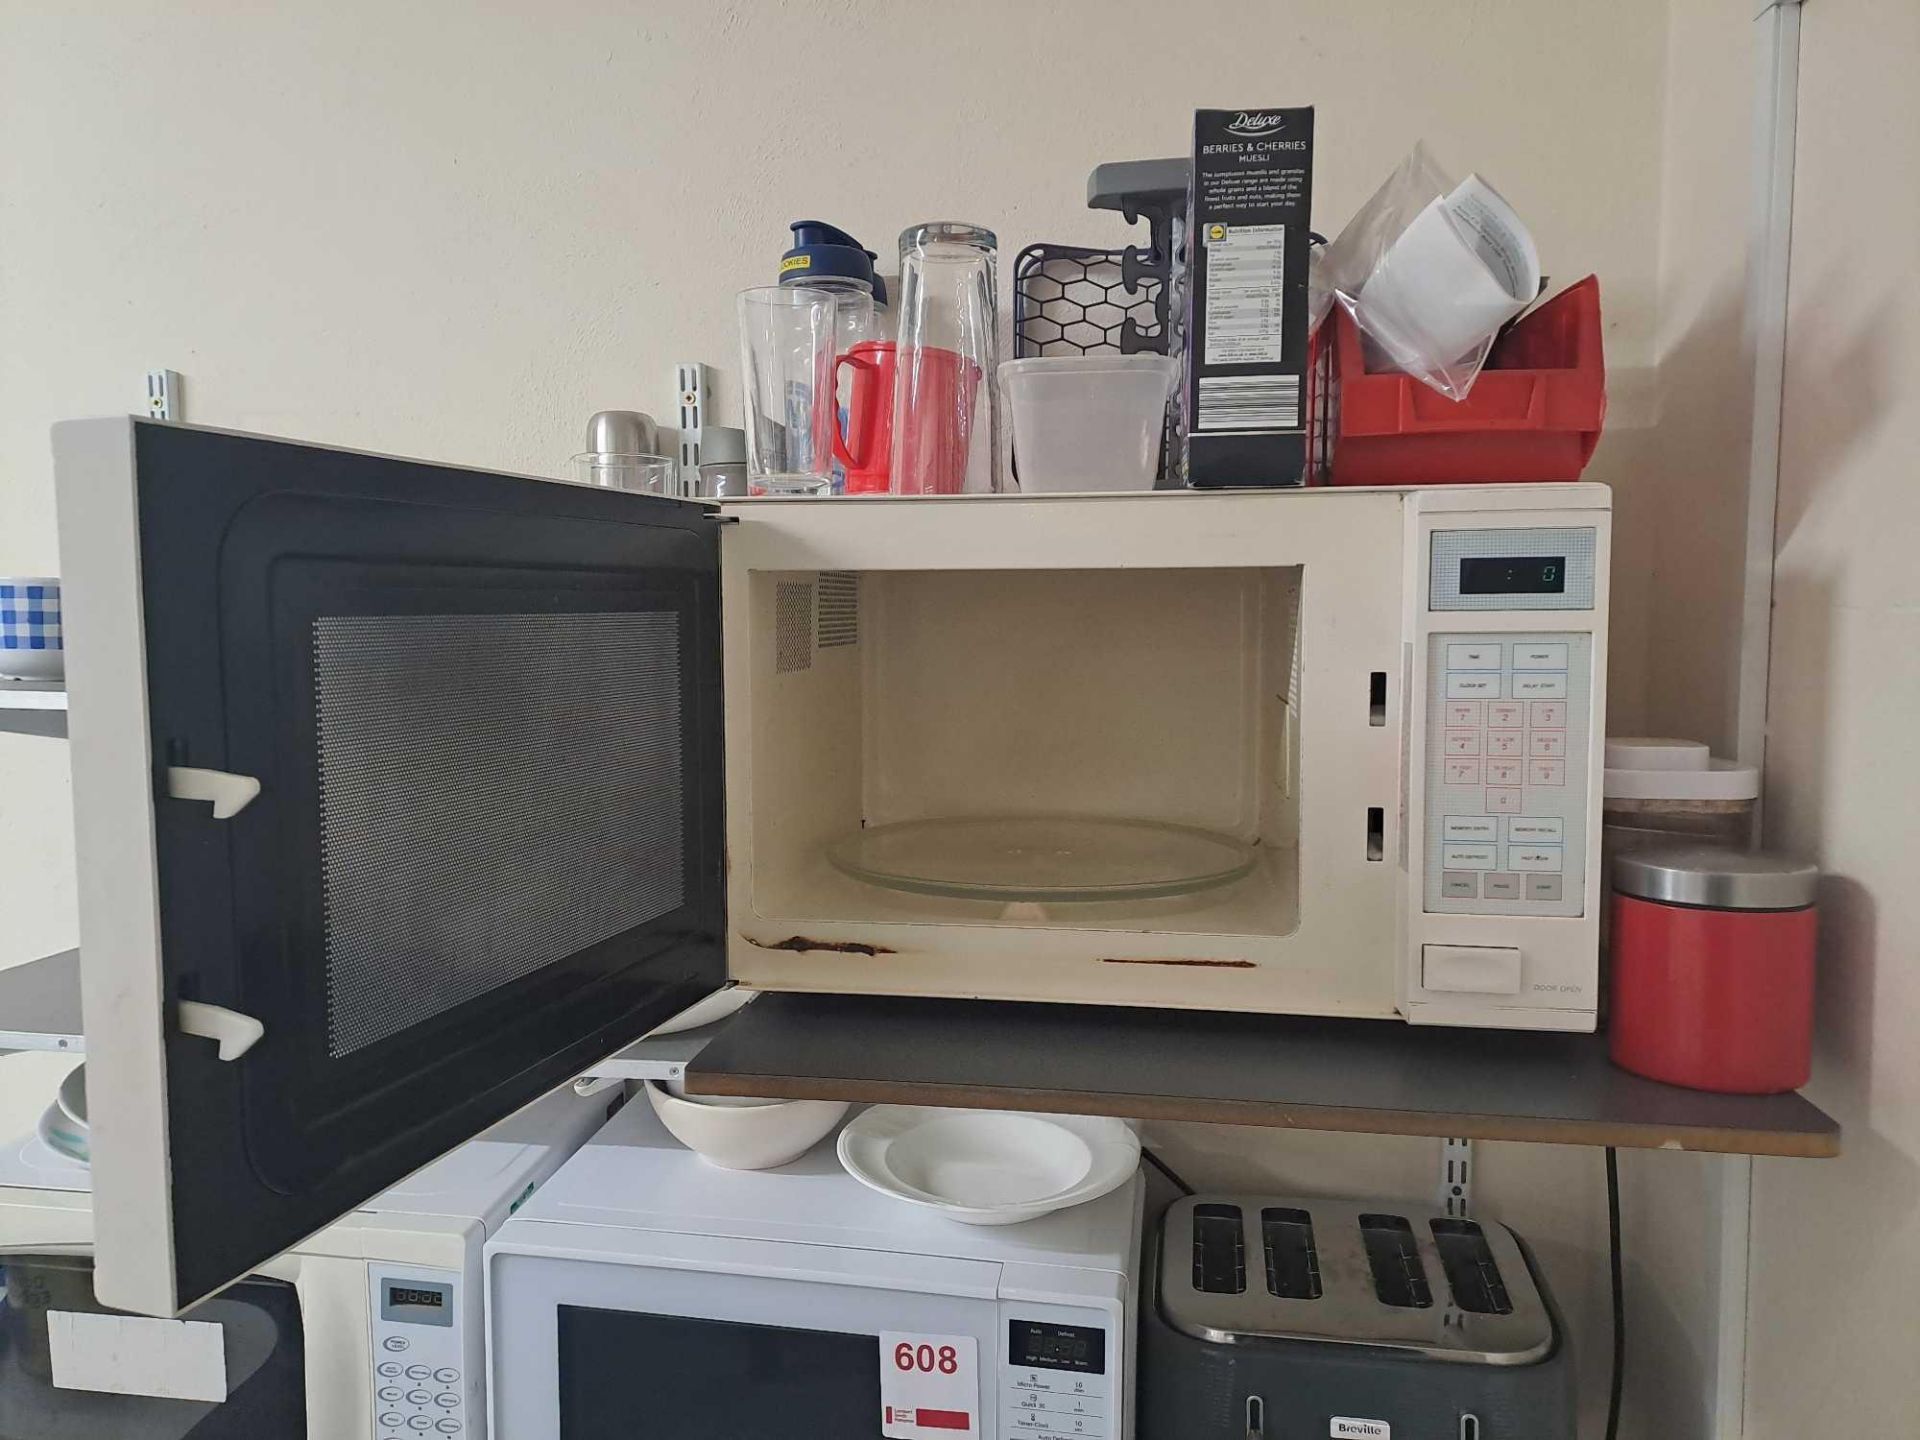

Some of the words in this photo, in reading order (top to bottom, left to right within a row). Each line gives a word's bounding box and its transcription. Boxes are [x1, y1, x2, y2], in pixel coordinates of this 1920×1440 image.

[1229, 112, 1281, 129] Deluxe
[1203, 143, 1244, 154] BERRIES
[1246, 143, 1254, 152] &
[1256, 141, 1306, 151] CHERRIES
[1239, 154, 1269, 162] MUESLI
[894, 1342, 958, 1375] 608
[1338, 1423, 1382, 1435] Breville
